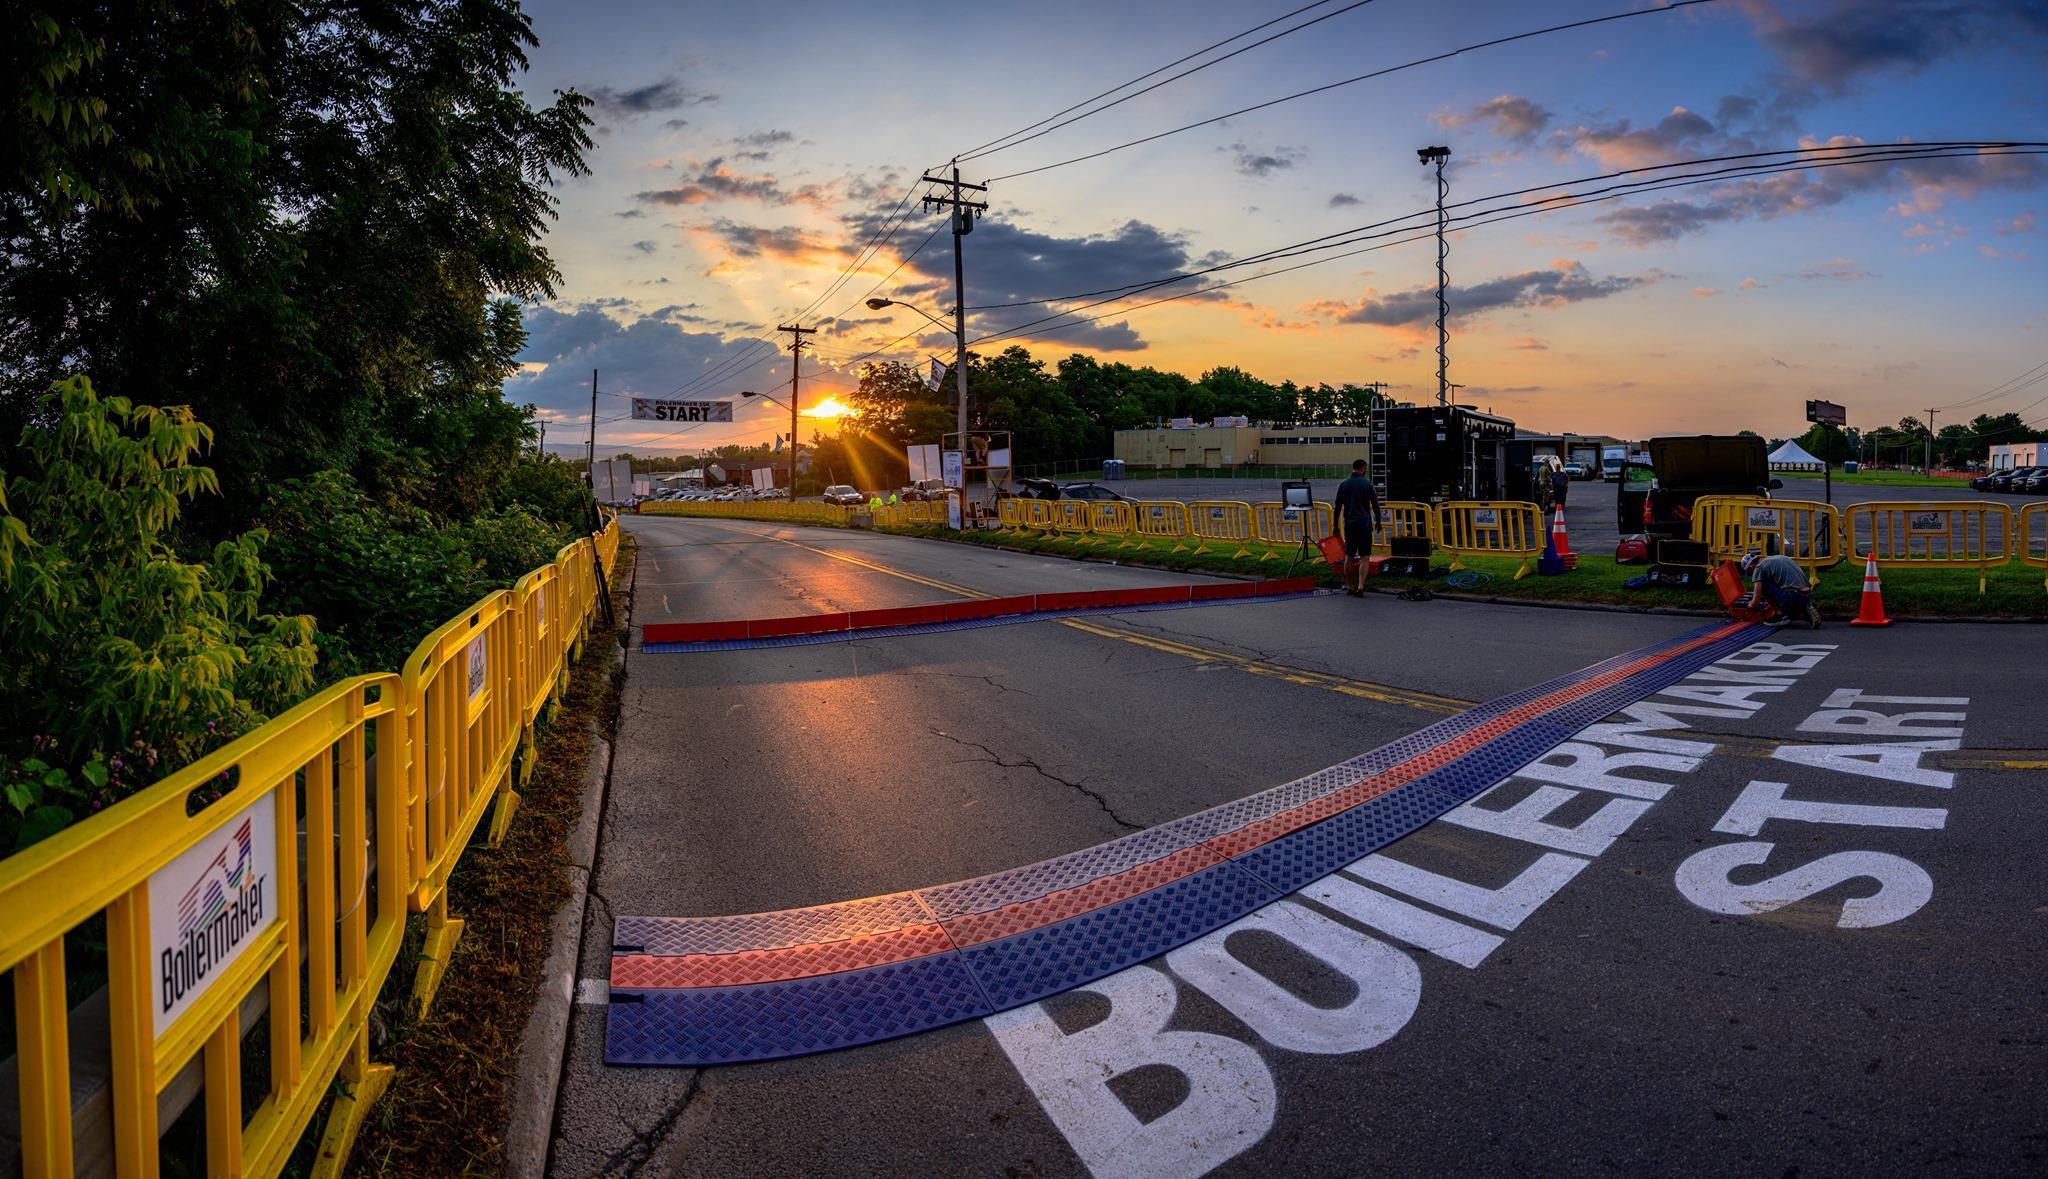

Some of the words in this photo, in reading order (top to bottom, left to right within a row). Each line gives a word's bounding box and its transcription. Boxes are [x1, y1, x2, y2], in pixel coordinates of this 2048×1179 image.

[655, 406, 711, 421] START
[1674, 687, 1970, 928] START
[161, 873, 267, 1014] Boilermaker
[983, 642, 1839, 1179] BOILERMAKER
